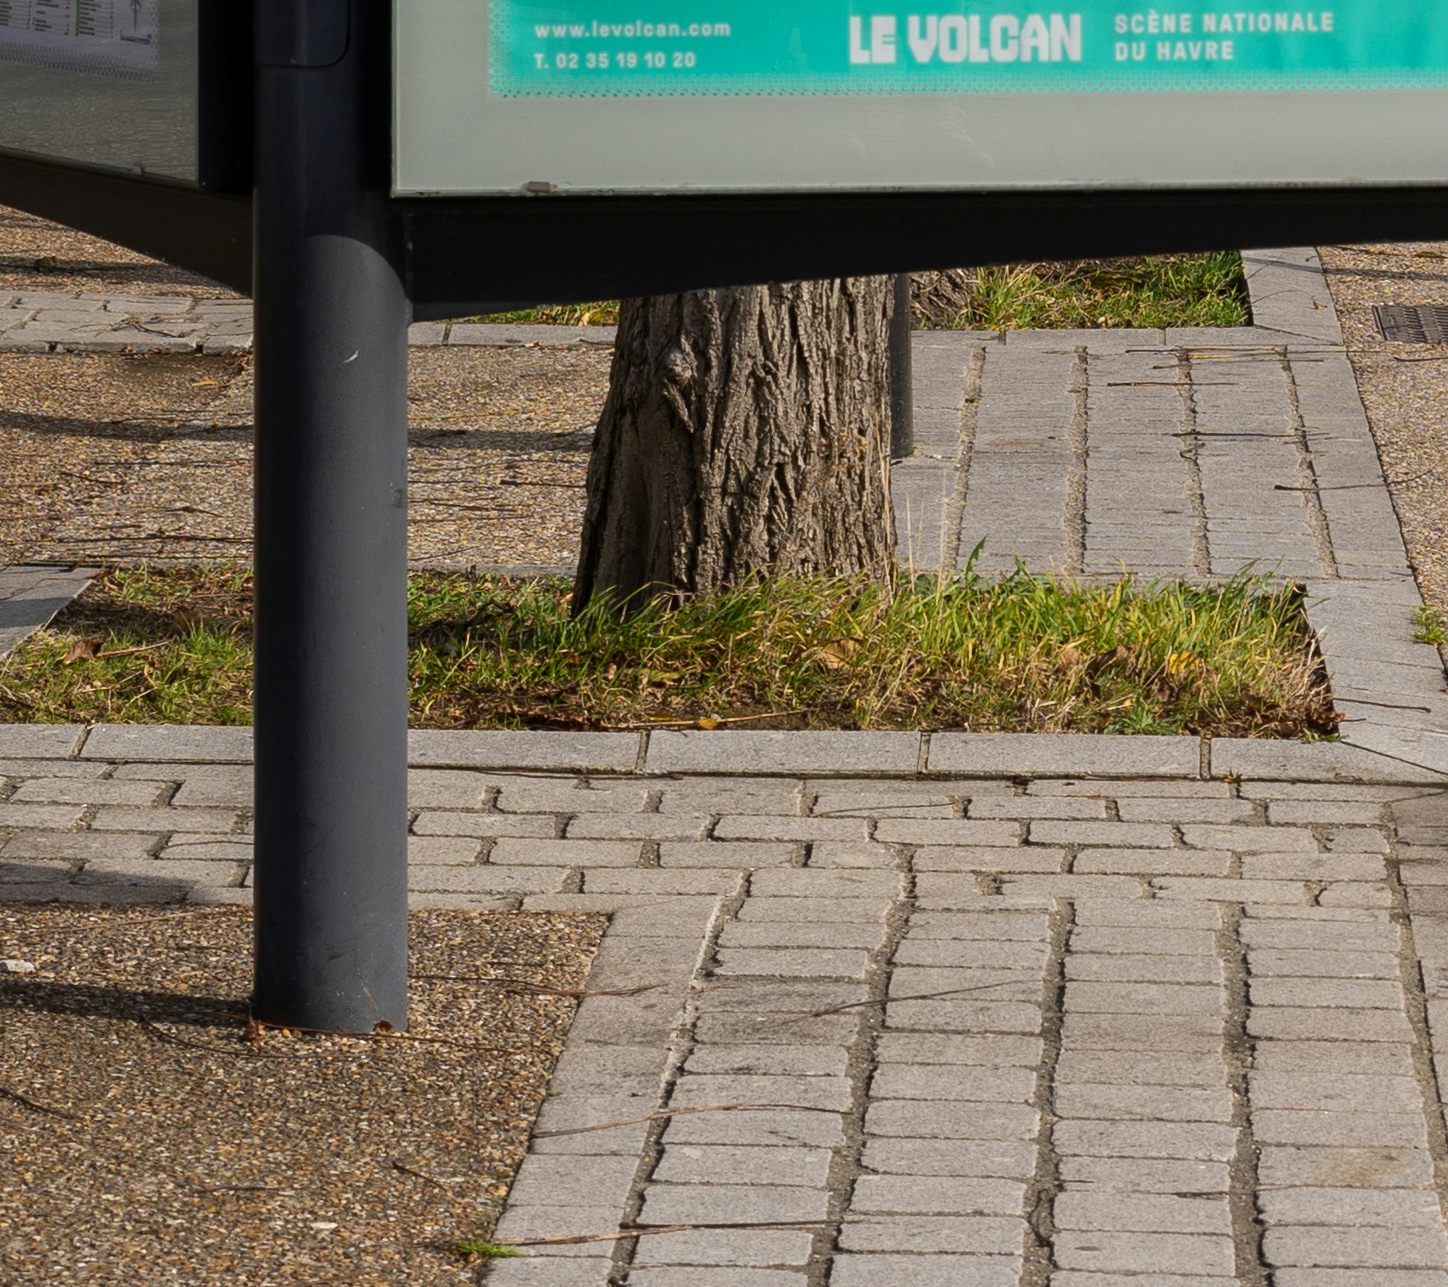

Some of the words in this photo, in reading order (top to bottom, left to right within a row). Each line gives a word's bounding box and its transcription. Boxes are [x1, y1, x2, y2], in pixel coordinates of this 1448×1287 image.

[534, 19, 732, 38] www.levolcan.com
[1114, 9, 1193, 34] SCÈNE
[1202, 12, 1334, 33] NATIONALE
[849, 15, 897, 64] LE
[907, 13, 1082, 63] VOLCAN
[1114, 41, 1146, 60] DU
[1156, 40, 1234, 60] HAVRE
[534, 53, 549, 69] T.
[555, 53, 579, 69] 02
[585, 53, 609, 69] 35
[615, 52, 638, 68] 19
[644, 52, 667, 68] 10
[673, 52, 697, 68] 20
